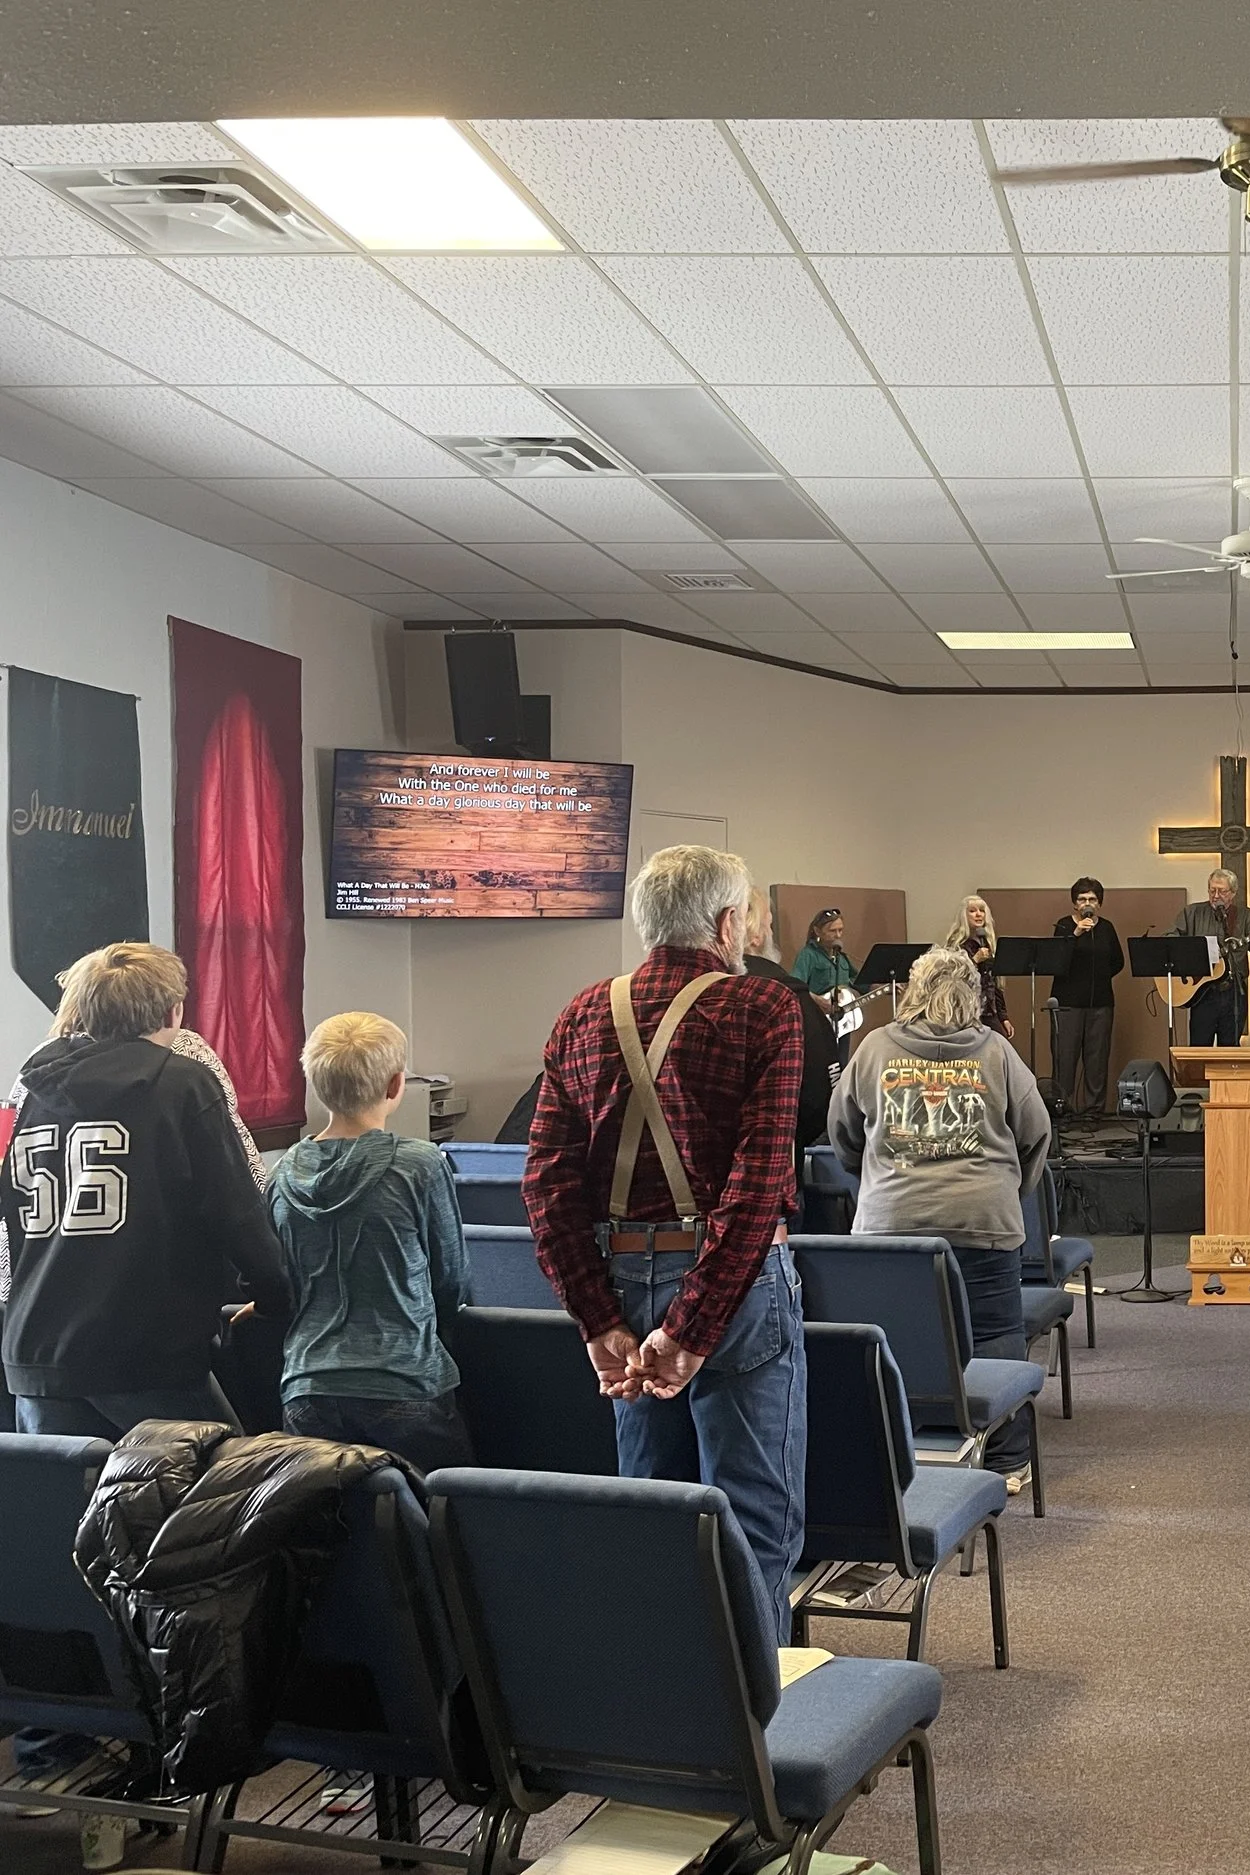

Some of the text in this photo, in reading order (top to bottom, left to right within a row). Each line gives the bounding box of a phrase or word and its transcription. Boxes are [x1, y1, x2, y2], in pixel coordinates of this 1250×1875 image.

[429, 763, 550, 780] And forever I will be
[398, 777, 578, 796] With the One who died for me
[379, 792, 592, 812] What a day glorious day that will be
[360, 882, 373, 890] Day
[880, 1067, 987, 1090] CENTRAL
[10, 1120, 131, 1239] 56
